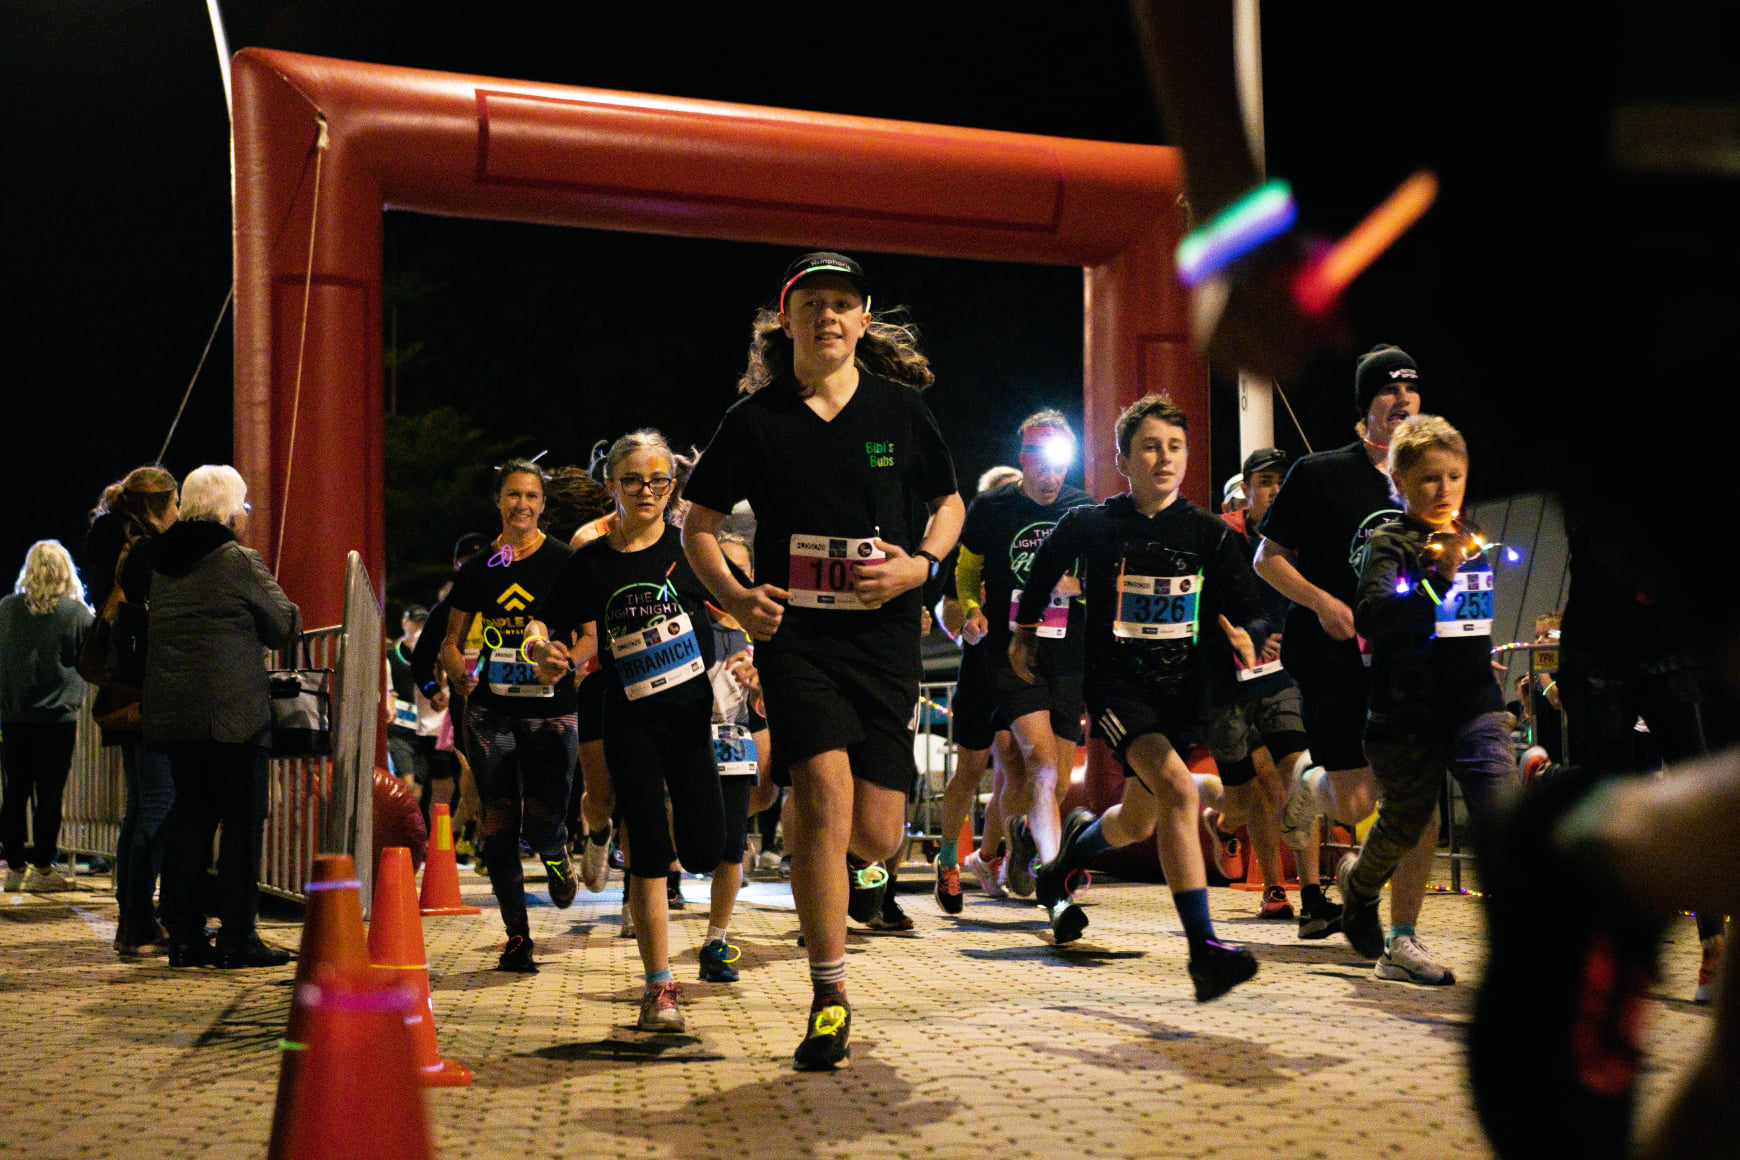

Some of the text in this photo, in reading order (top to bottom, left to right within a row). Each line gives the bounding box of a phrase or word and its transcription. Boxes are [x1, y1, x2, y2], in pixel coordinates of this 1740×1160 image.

[870, 455, 894, 467] Bubs
[1010, 552, 1035, 572] Gl
[625, 591, 652, 604] THE
[1454, 592, 1489, 619] 253
[639, 602, 678, 617] NIGHT
[1134, 596, 1185, 623] 326
[622, 638, 695, 679] BRAMICH
